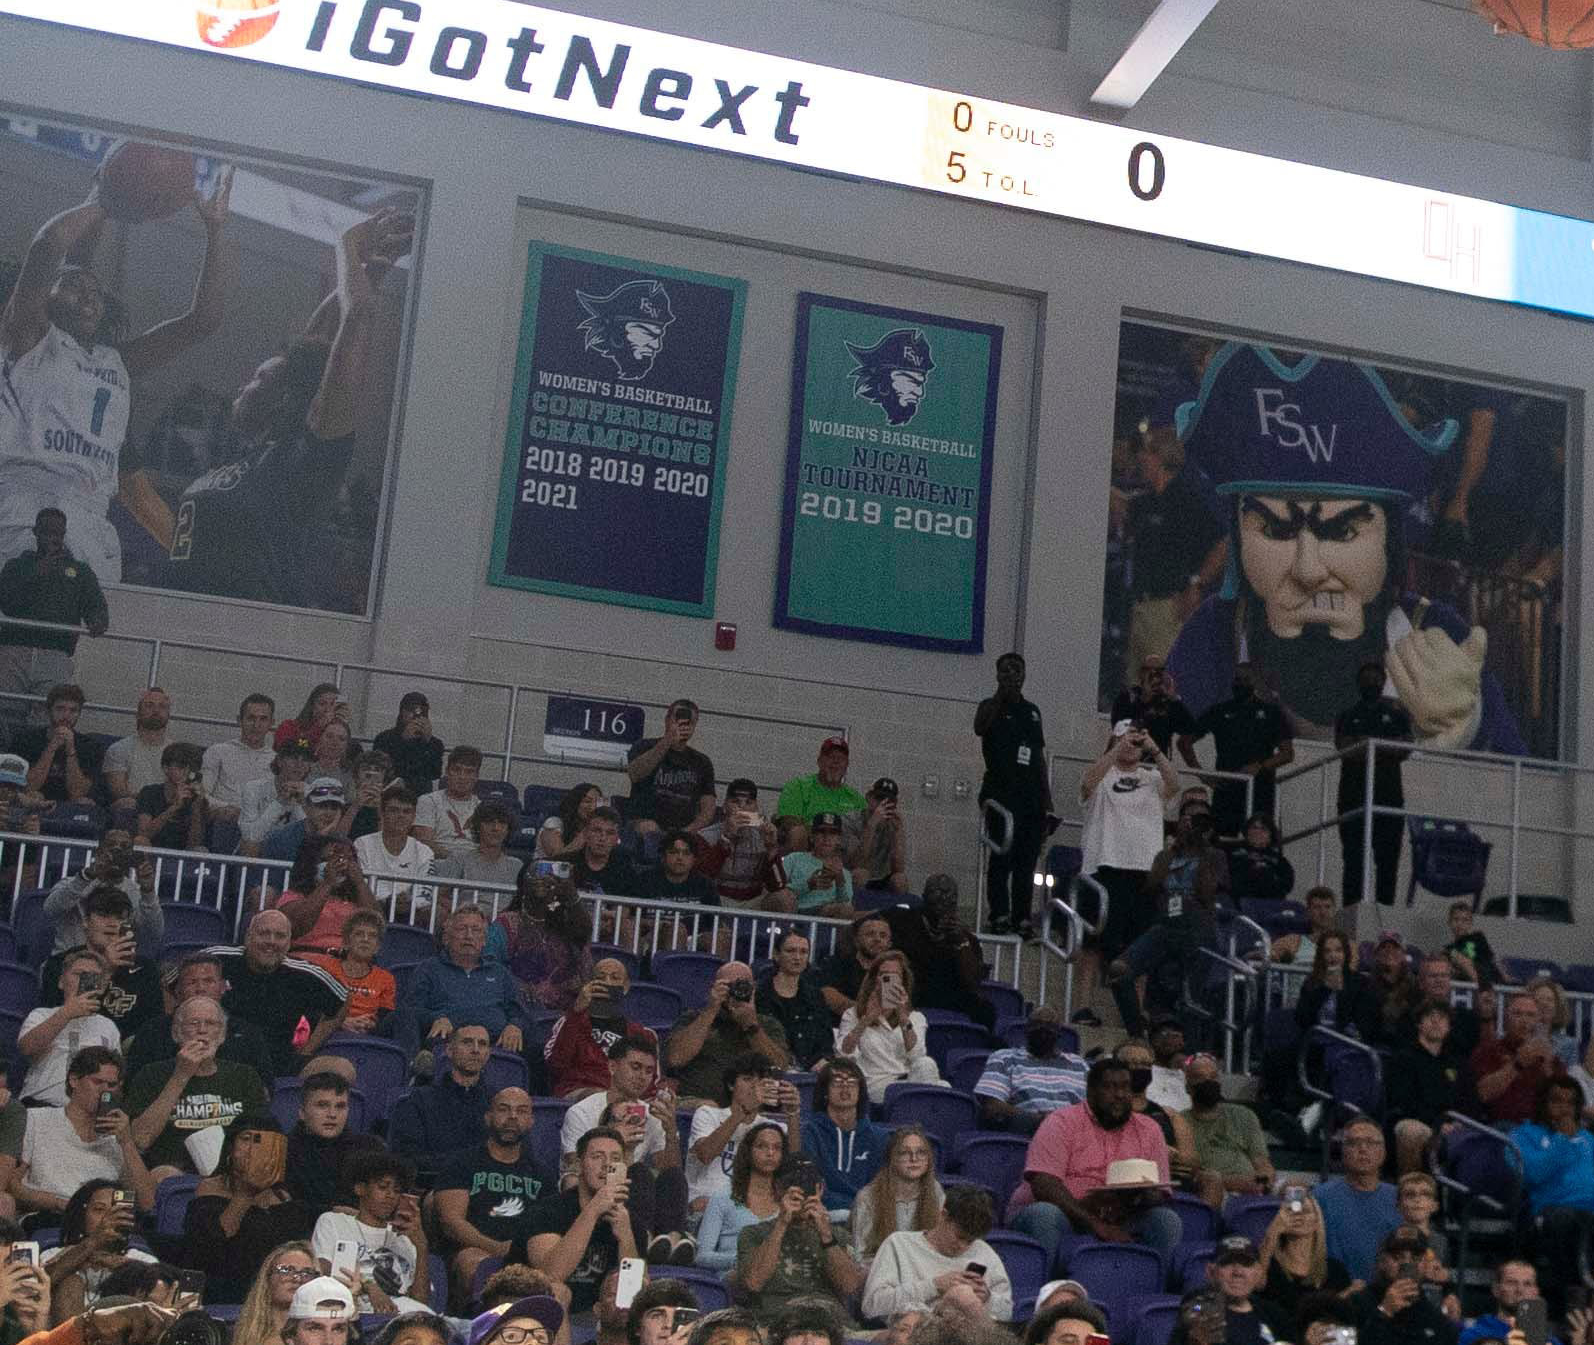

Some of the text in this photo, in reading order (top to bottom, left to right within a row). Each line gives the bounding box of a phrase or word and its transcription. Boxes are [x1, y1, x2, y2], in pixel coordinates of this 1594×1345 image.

[953, 101, 1055, 148] 0 FOULS
[946, 151, 966, 183] 5
[1128, 141, 1165, 201] 0
[532, 391, 714, 440] CONFERENCE
[538, 370, 713, 415] WOMEN'S BASKETBALL
[529, 416, 712, 465] CHAMPIONS
[808, 419, 977, 458] WOMEN'S BASKETBALL
[1254, 388, 1337, 463] FSW
[526, 446, 709, 497] 2018 2019 2020
[852, 446, 929, 479] NJCAA
[522, 479, 578, 509] 2021
[803, 463, 975, 509] TOURNAMENT
[800, 492, 974, 539] 2019 2020
[583, 709, 626, 735] 116
[470, 1171, 542, 1200] FGCU
